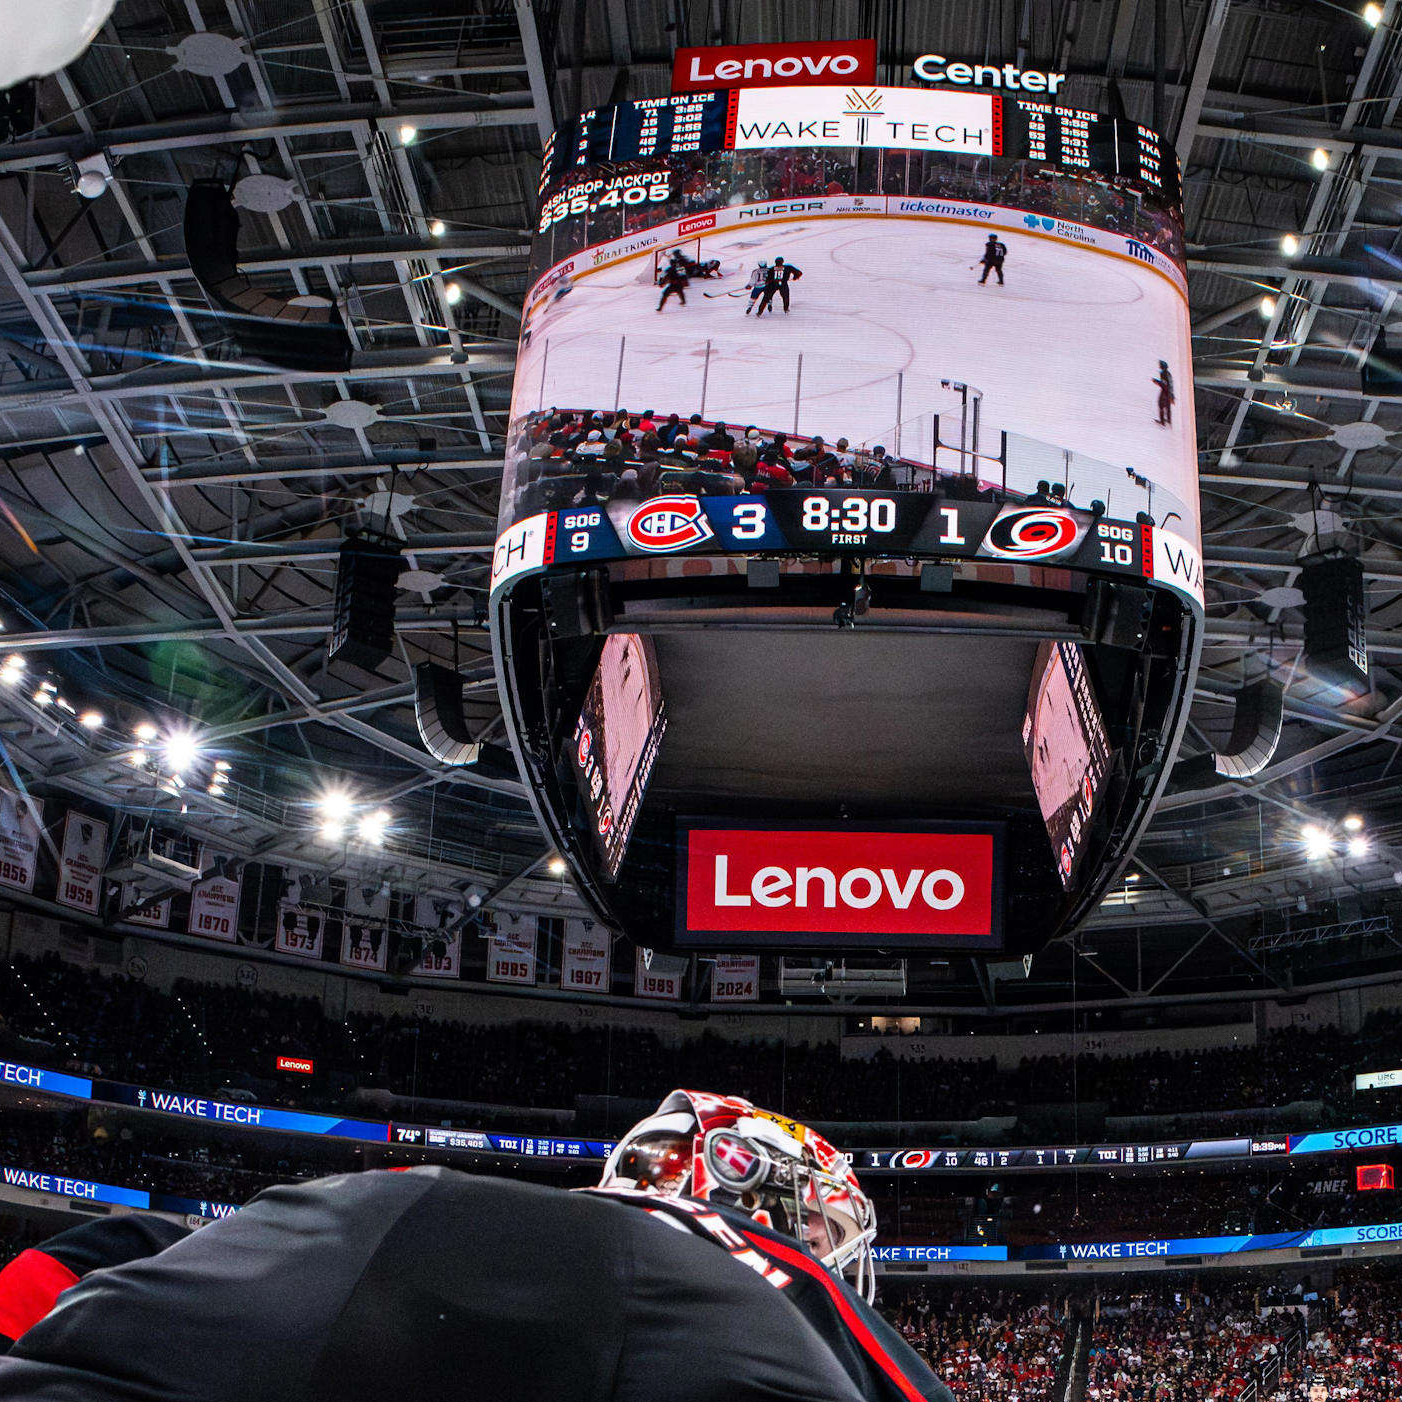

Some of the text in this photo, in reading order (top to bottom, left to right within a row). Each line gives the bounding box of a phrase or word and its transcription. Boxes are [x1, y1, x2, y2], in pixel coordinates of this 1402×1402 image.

[689, 55, 859, 82] Lenovo
[913, 54, 1066, 95] Center
[633, 93, 716, 110] TIME ON ICE
[579, 110, 596, 124] 14
[644, 108, 659, 118] 71
[1017, 100, 1099, 122] TIME ON ICE
[1029, 113, 1044, 122] 71
[582, 126, 588, 136] 1
[739, 121, 984, 146] WAKE TECH
[1138, 125, 1159, 144] SAT
[578, 140, 588, 150] 3
[639, 146, 656, 156] 47
[1061, 146, 1089, 158] 4:11
[1138, 140, 1161, 158] TKA
[576, 155, 586, 166] 4
[1139, 155, 1160, 171] HIT
[1140, 169, 1162, 187] BLK
[541, 170, 671, 216] CASH DROP JACKPOT
[539, 184, 670, 234] $35,405
[739, 201, 824, 219] NUCOR
[899, 200, 996, 219] ticketmaster
[680, 218, 714, 233] Lenovo
[1057, 221, 1084, 234] North
[1057, 228, 1096, 244] Carolina
[564, 513, 601, 530] SOG
[732, 503, 767, 540] 3
[802, 496, 897, 533] 8:30
[939, 507, 966, 545] 1
[1098, 524, 1134, 542] SOG
[570, 532, 590, 552] 9
[832, 534, 868, 545] FIRST
[1100, 542, 1134, 566] 10
[713, 854, 965, 910] Lenovo
[496, 960, 528, 978] 1985
[570, 968, 602, 986] 1987
[716, 981, 753, 996] 2024
[280, 1059, 311, 1071] Lenovo
[151, 1092, 261, 1124] WAKE TECH
[450, 1139, 484, 1149] $35,405
[499, 1139, 517, 1150] TOI
[1334, 1127, 1397, 1149] SCORE
[871, 1153, 880, 1166] 1
[945, 1157, 958, 1166] 10
[974, 1156, 988, 1166] 46
[1000, 1156, 1008, 1166] 2
[1098, 1151, 1117, 1160] TOI
[4, 1168, 95, 1198] WAKE TECH
[211, 1203, 237, 1219] WA
[864, 1247, 948, 1260] AKE TECH
[1071, 1242, 1168, 1257] WAKE TECH
